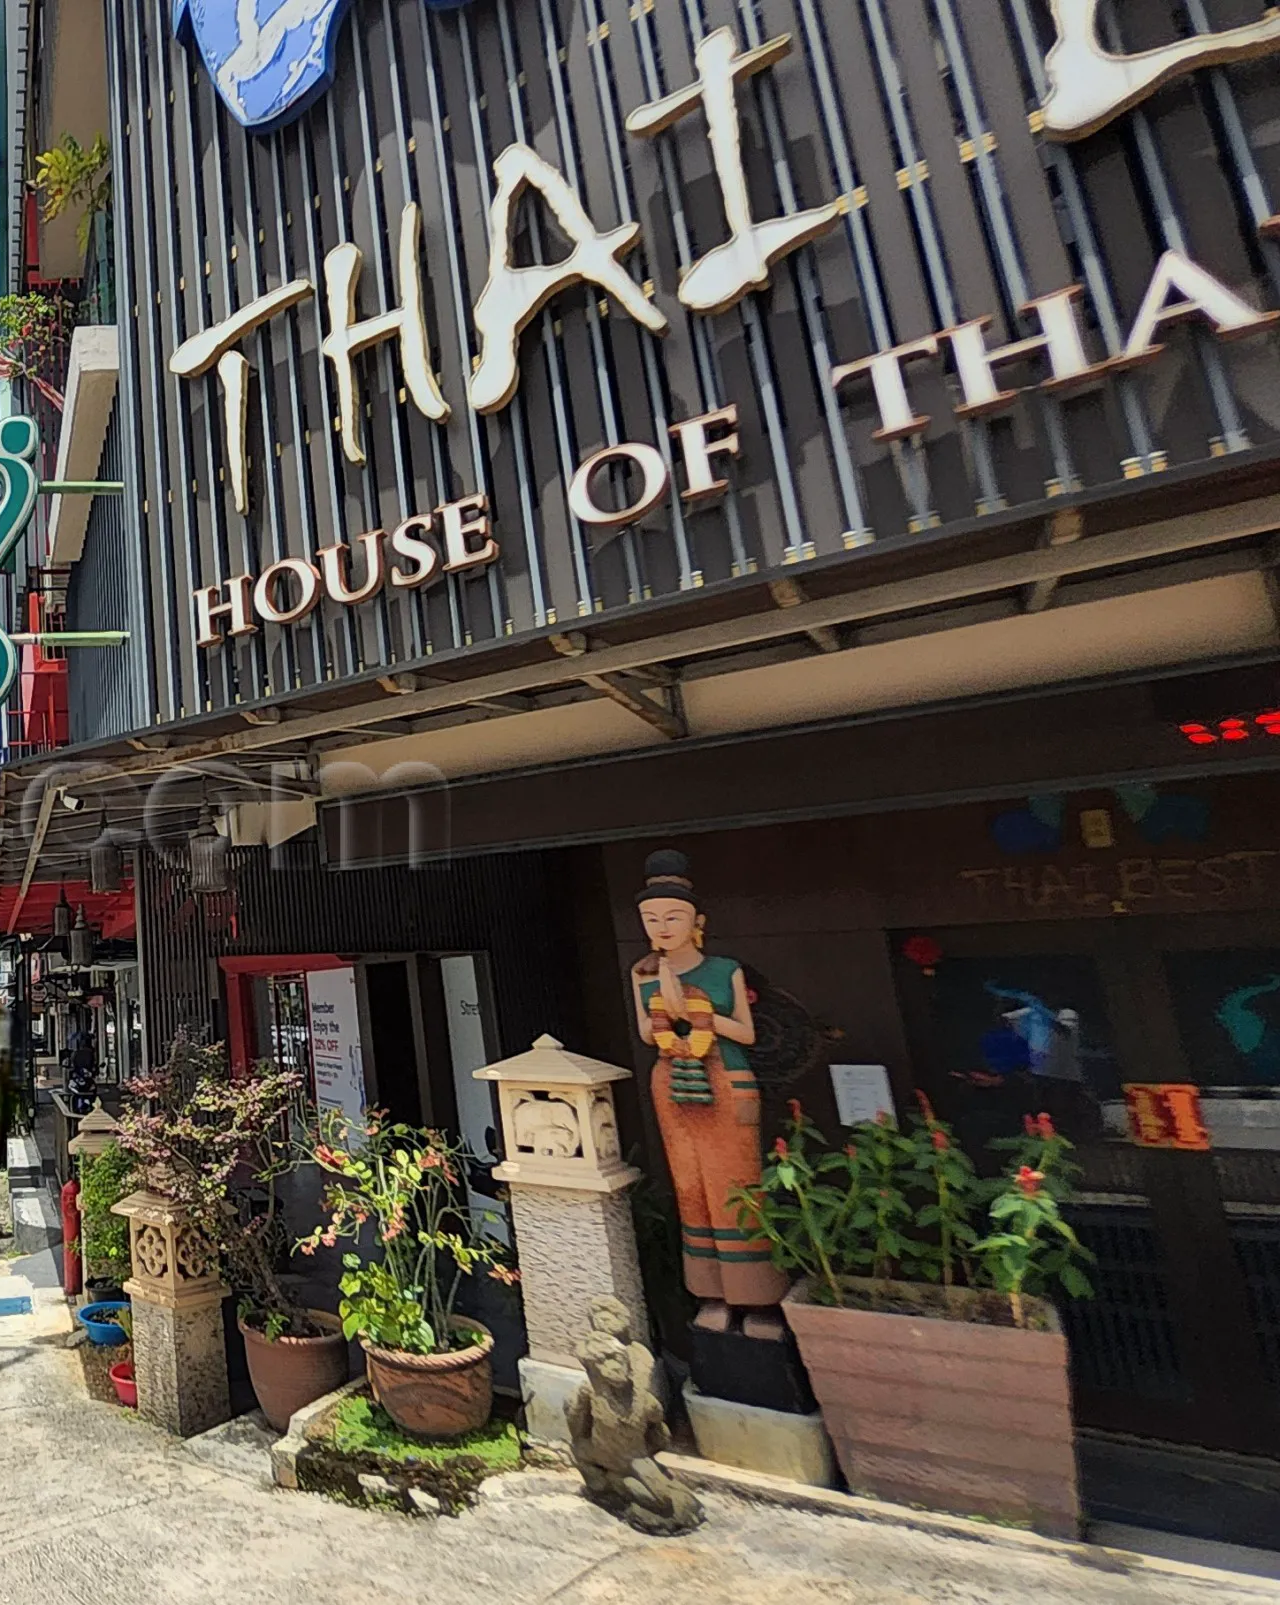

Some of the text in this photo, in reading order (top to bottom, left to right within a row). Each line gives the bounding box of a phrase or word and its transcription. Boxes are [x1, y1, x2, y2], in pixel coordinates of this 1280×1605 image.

[170, 25, 840, 515] THAI
[192, 214, 1280, 648] HOUSE OF THA
